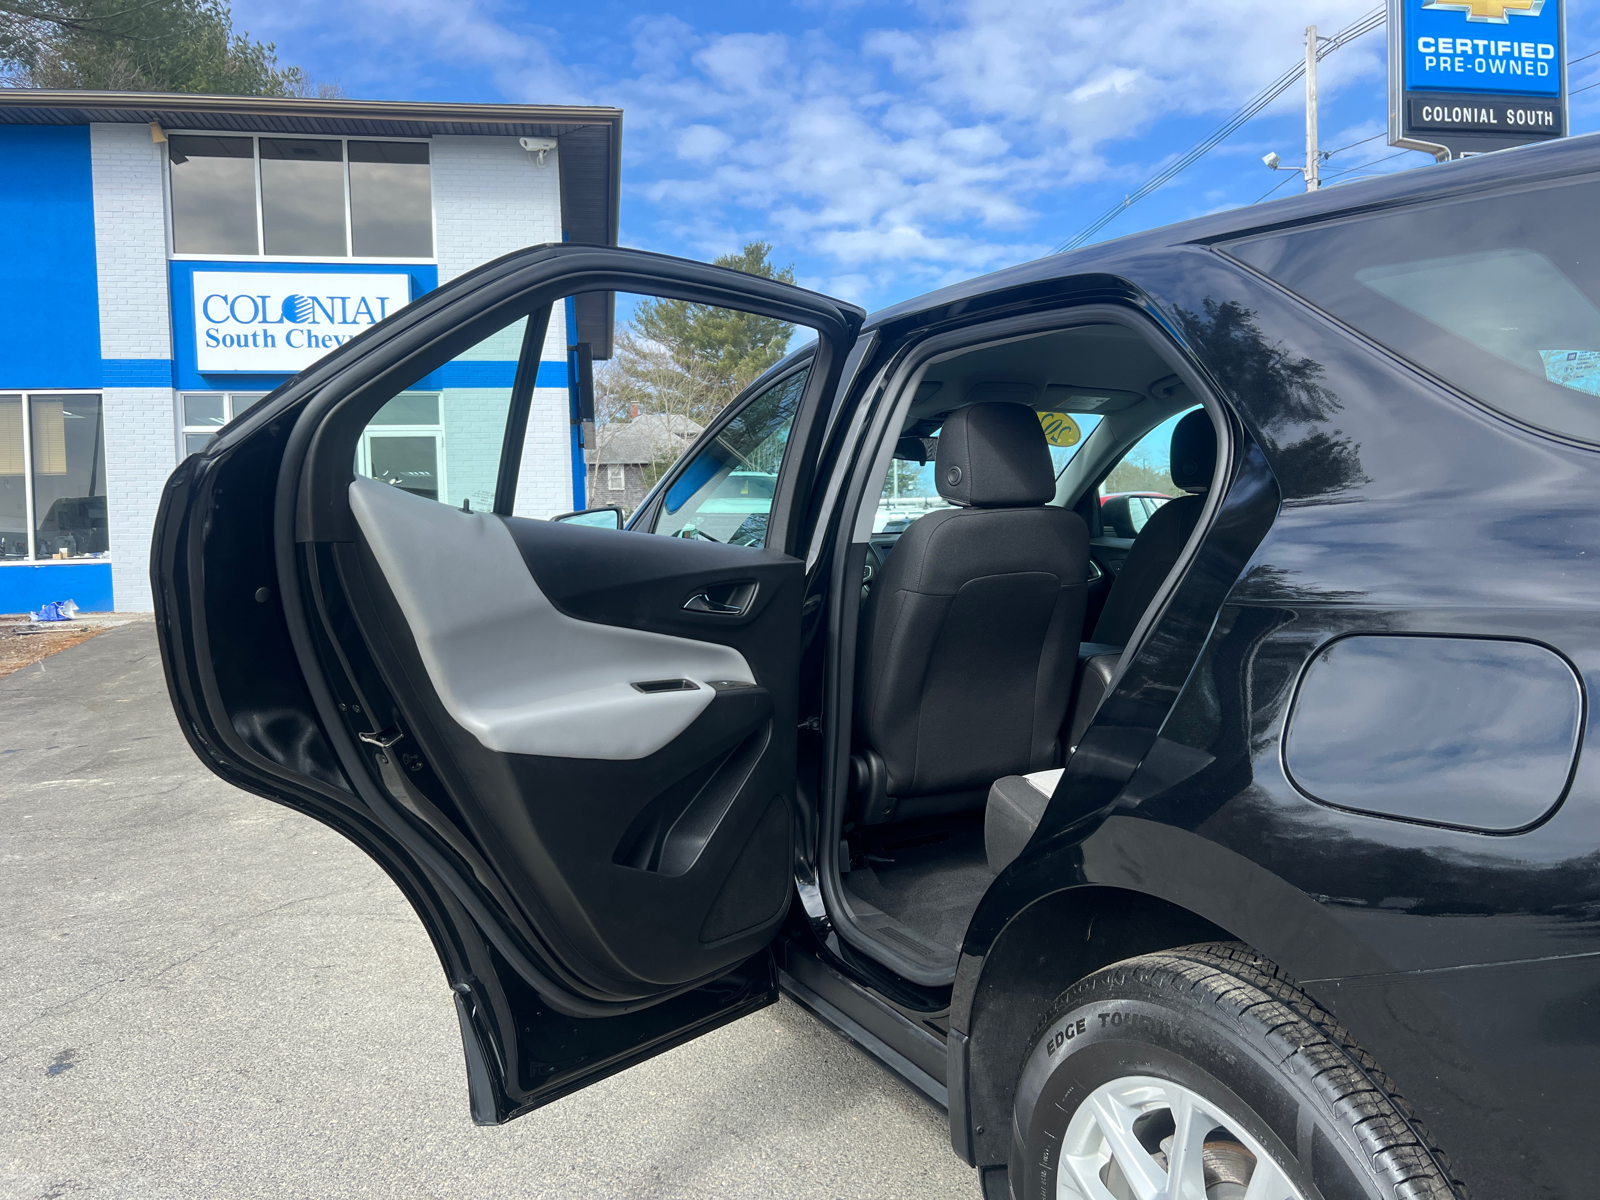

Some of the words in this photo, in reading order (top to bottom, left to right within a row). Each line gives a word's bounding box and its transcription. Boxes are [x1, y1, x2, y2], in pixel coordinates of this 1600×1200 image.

[1417, 36, 1555, 60] CERTIFIED
[1425, 55, 1549, 77] PRE-OWNED
[1422, 105, 1498, 124] COLONIAL
[1506, 109, 1554, 126] SOUTH
[205, 327, 277, 349] South
[285, 328, 354, 349] Chev
[1046, 1017, 1087, 1058] EDGE
